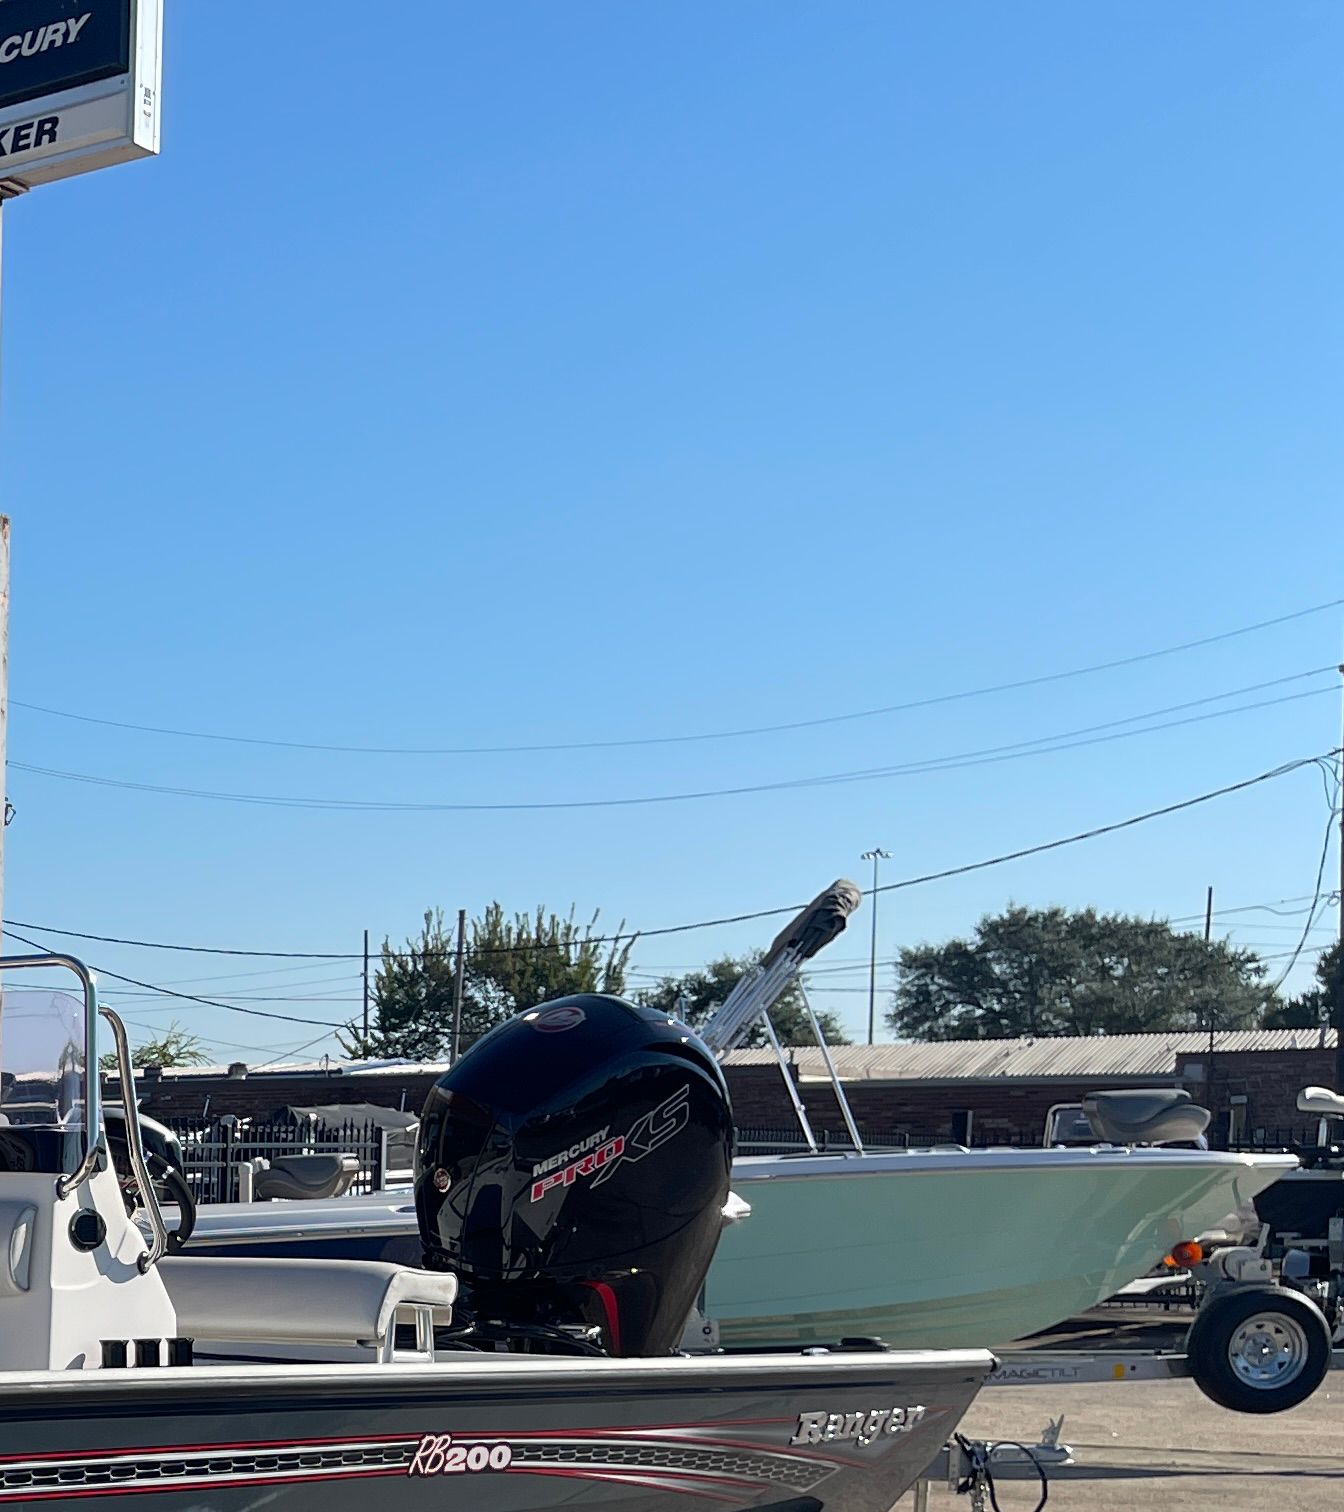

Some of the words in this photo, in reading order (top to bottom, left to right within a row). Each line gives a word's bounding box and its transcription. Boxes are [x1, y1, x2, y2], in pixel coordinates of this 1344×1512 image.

[530, 1135, 625, 1202] PRO
[533, 1125, 610, 1177] MERCURY
[791, 1405, 926, 1447] Ranger
[408, 1434, 512, 1475] RB200
